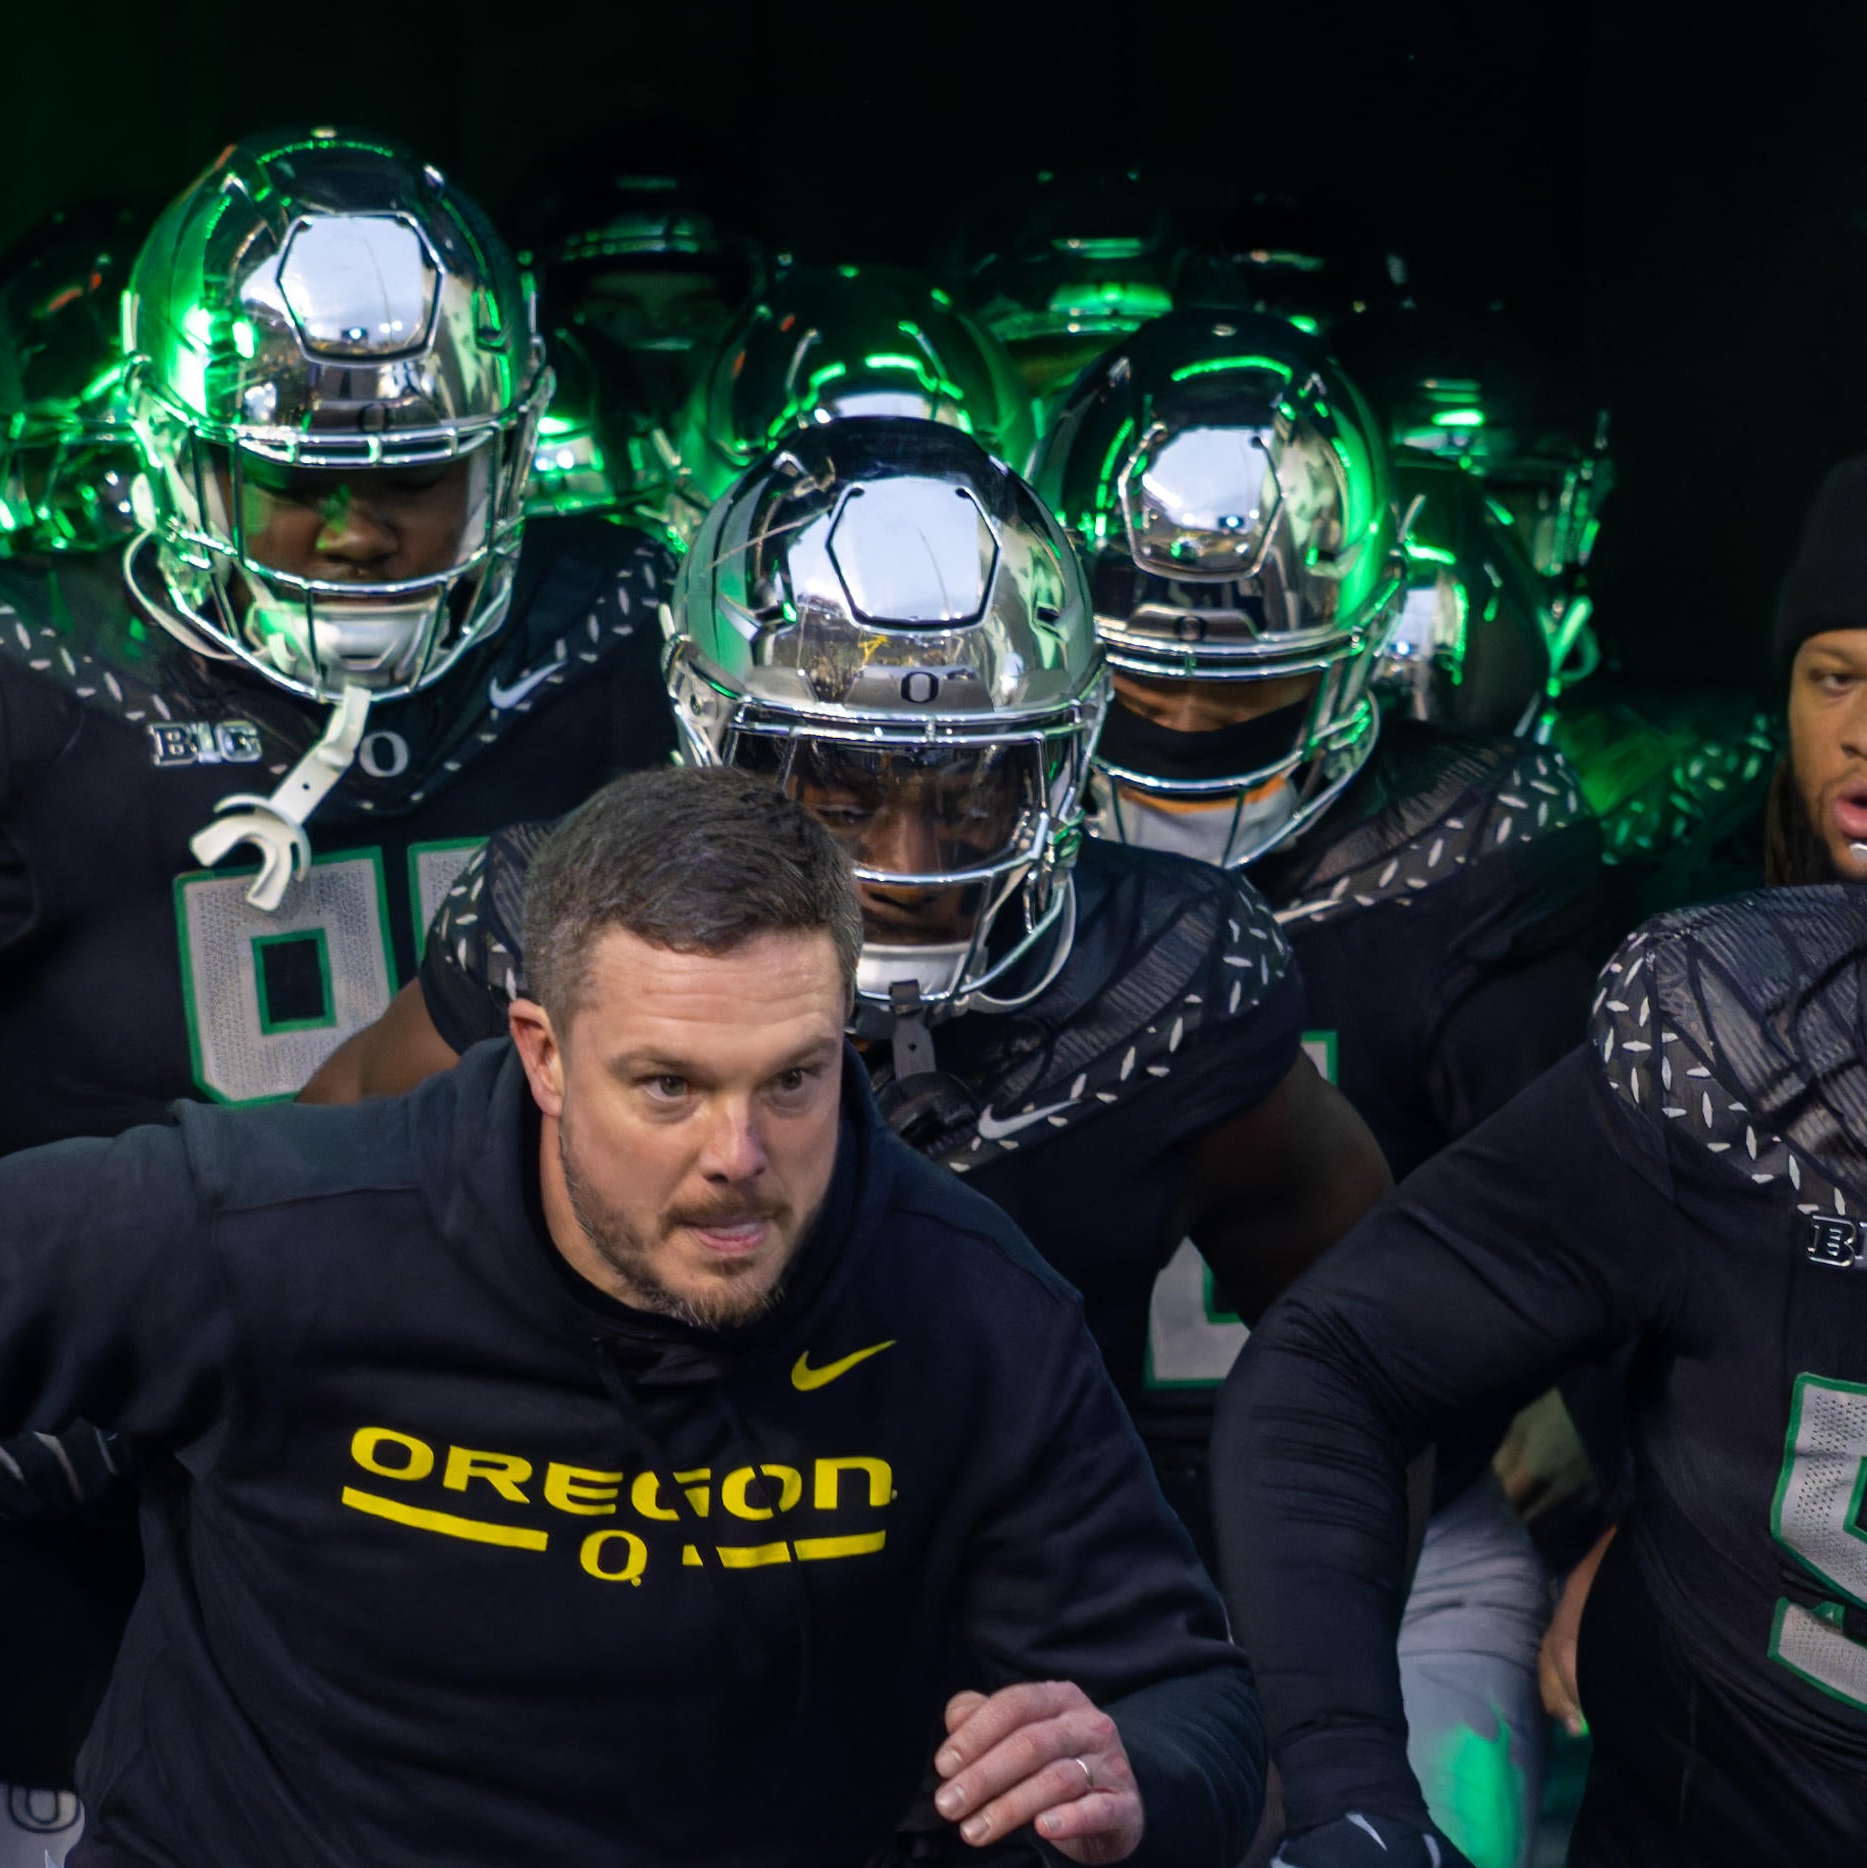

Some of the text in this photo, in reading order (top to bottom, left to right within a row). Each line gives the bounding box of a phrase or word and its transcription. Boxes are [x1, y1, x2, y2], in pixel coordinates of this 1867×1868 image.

[900, 671, 939, 703] O
[359, 730, 409, 777] O
[350, 1425, 893, 1522] OREGON
[579, 1529, 648, 1582] O
